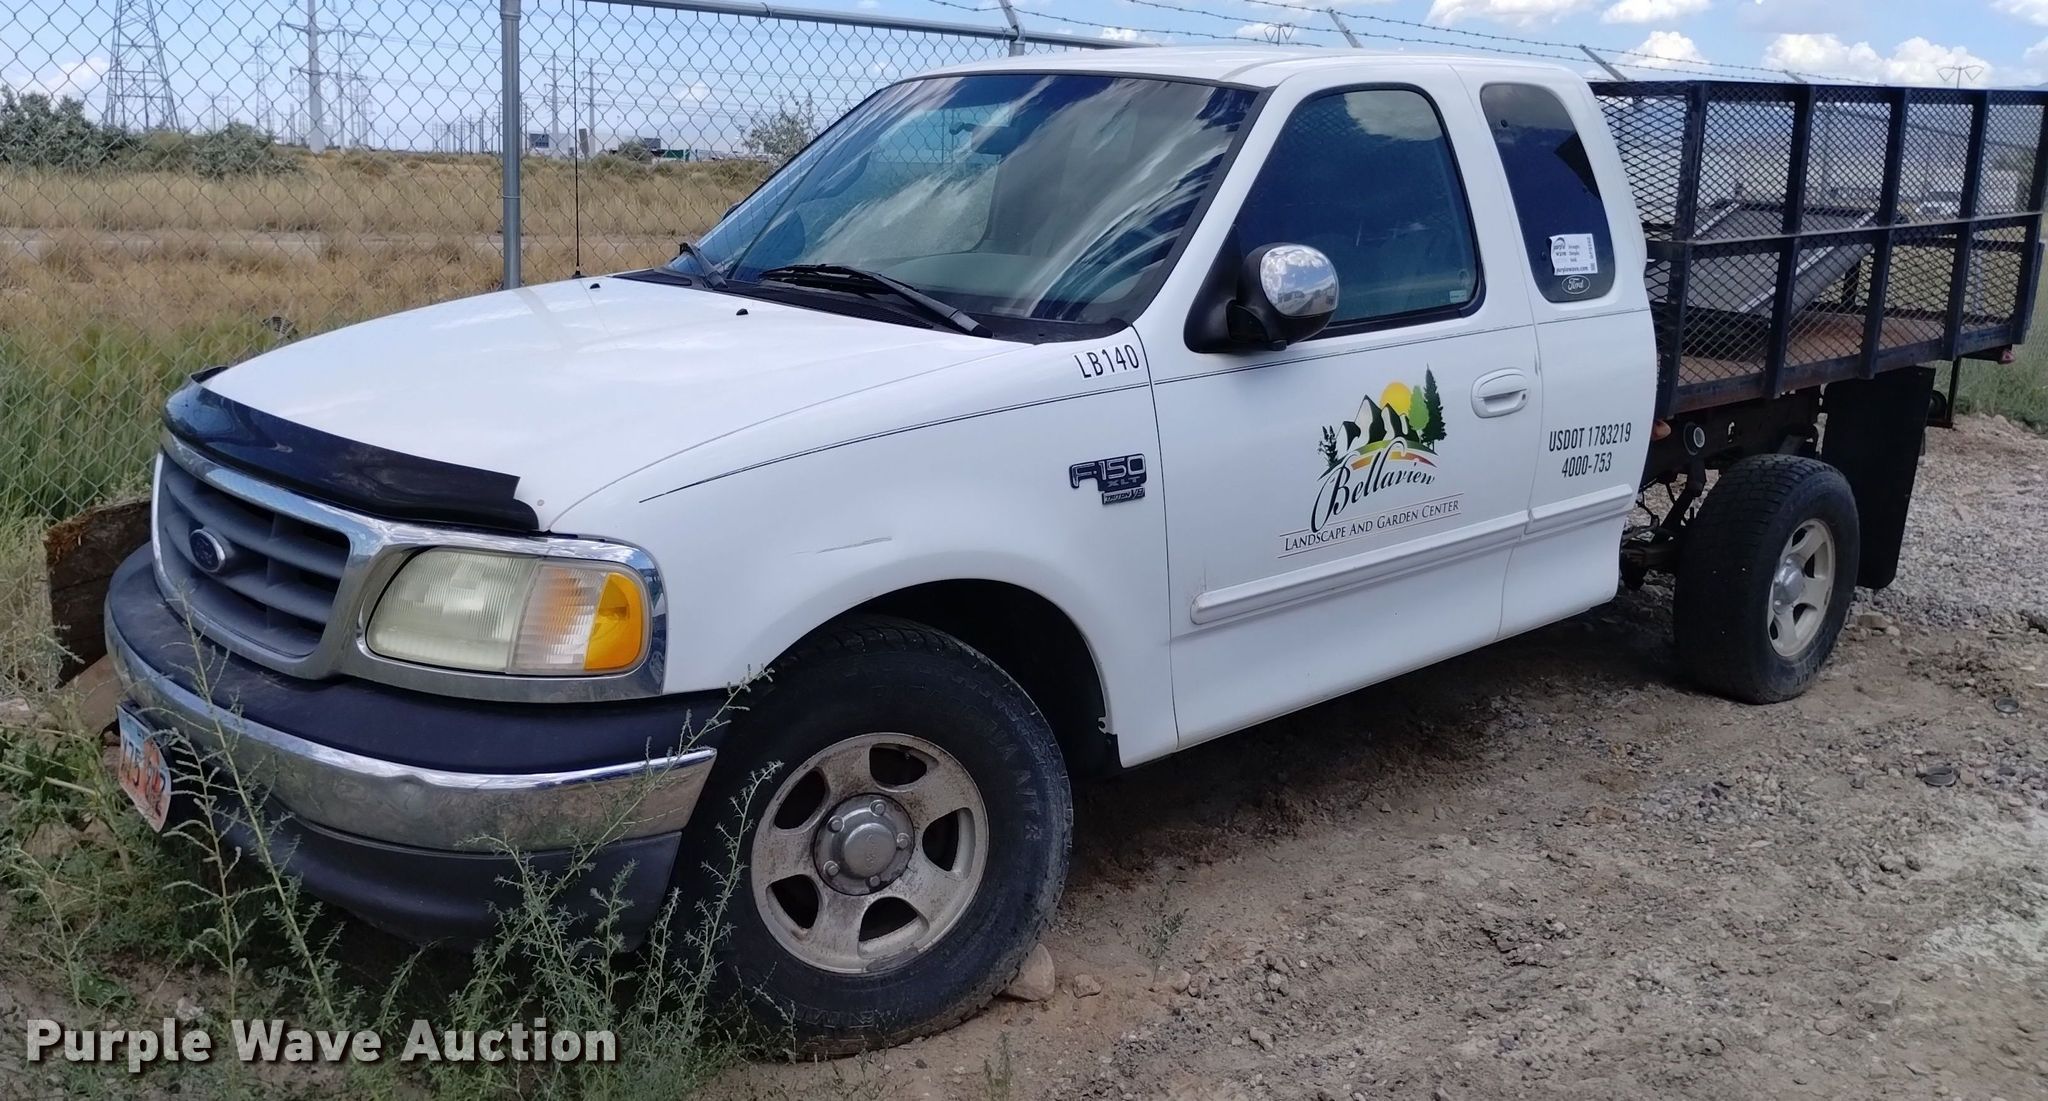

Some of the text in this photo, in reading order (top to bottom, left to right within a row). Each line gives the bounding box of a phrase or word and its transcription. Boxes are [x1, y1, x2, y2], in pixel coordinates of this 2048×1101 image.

[1074, 344, 1139, 378] LB140
[1548, 422, 1632, 452] USDOT 1783219
[1561, 451, 1612, 478] 4000-753
[1105, 487, 1144, 502] TRITON V8
[1107, 476, 1141, 488] XLT
[1310, 440, 1436, 534] Bellaview
[1285, 500, 1460, 551] LANDSCAPE AND GARDEN CENTER
